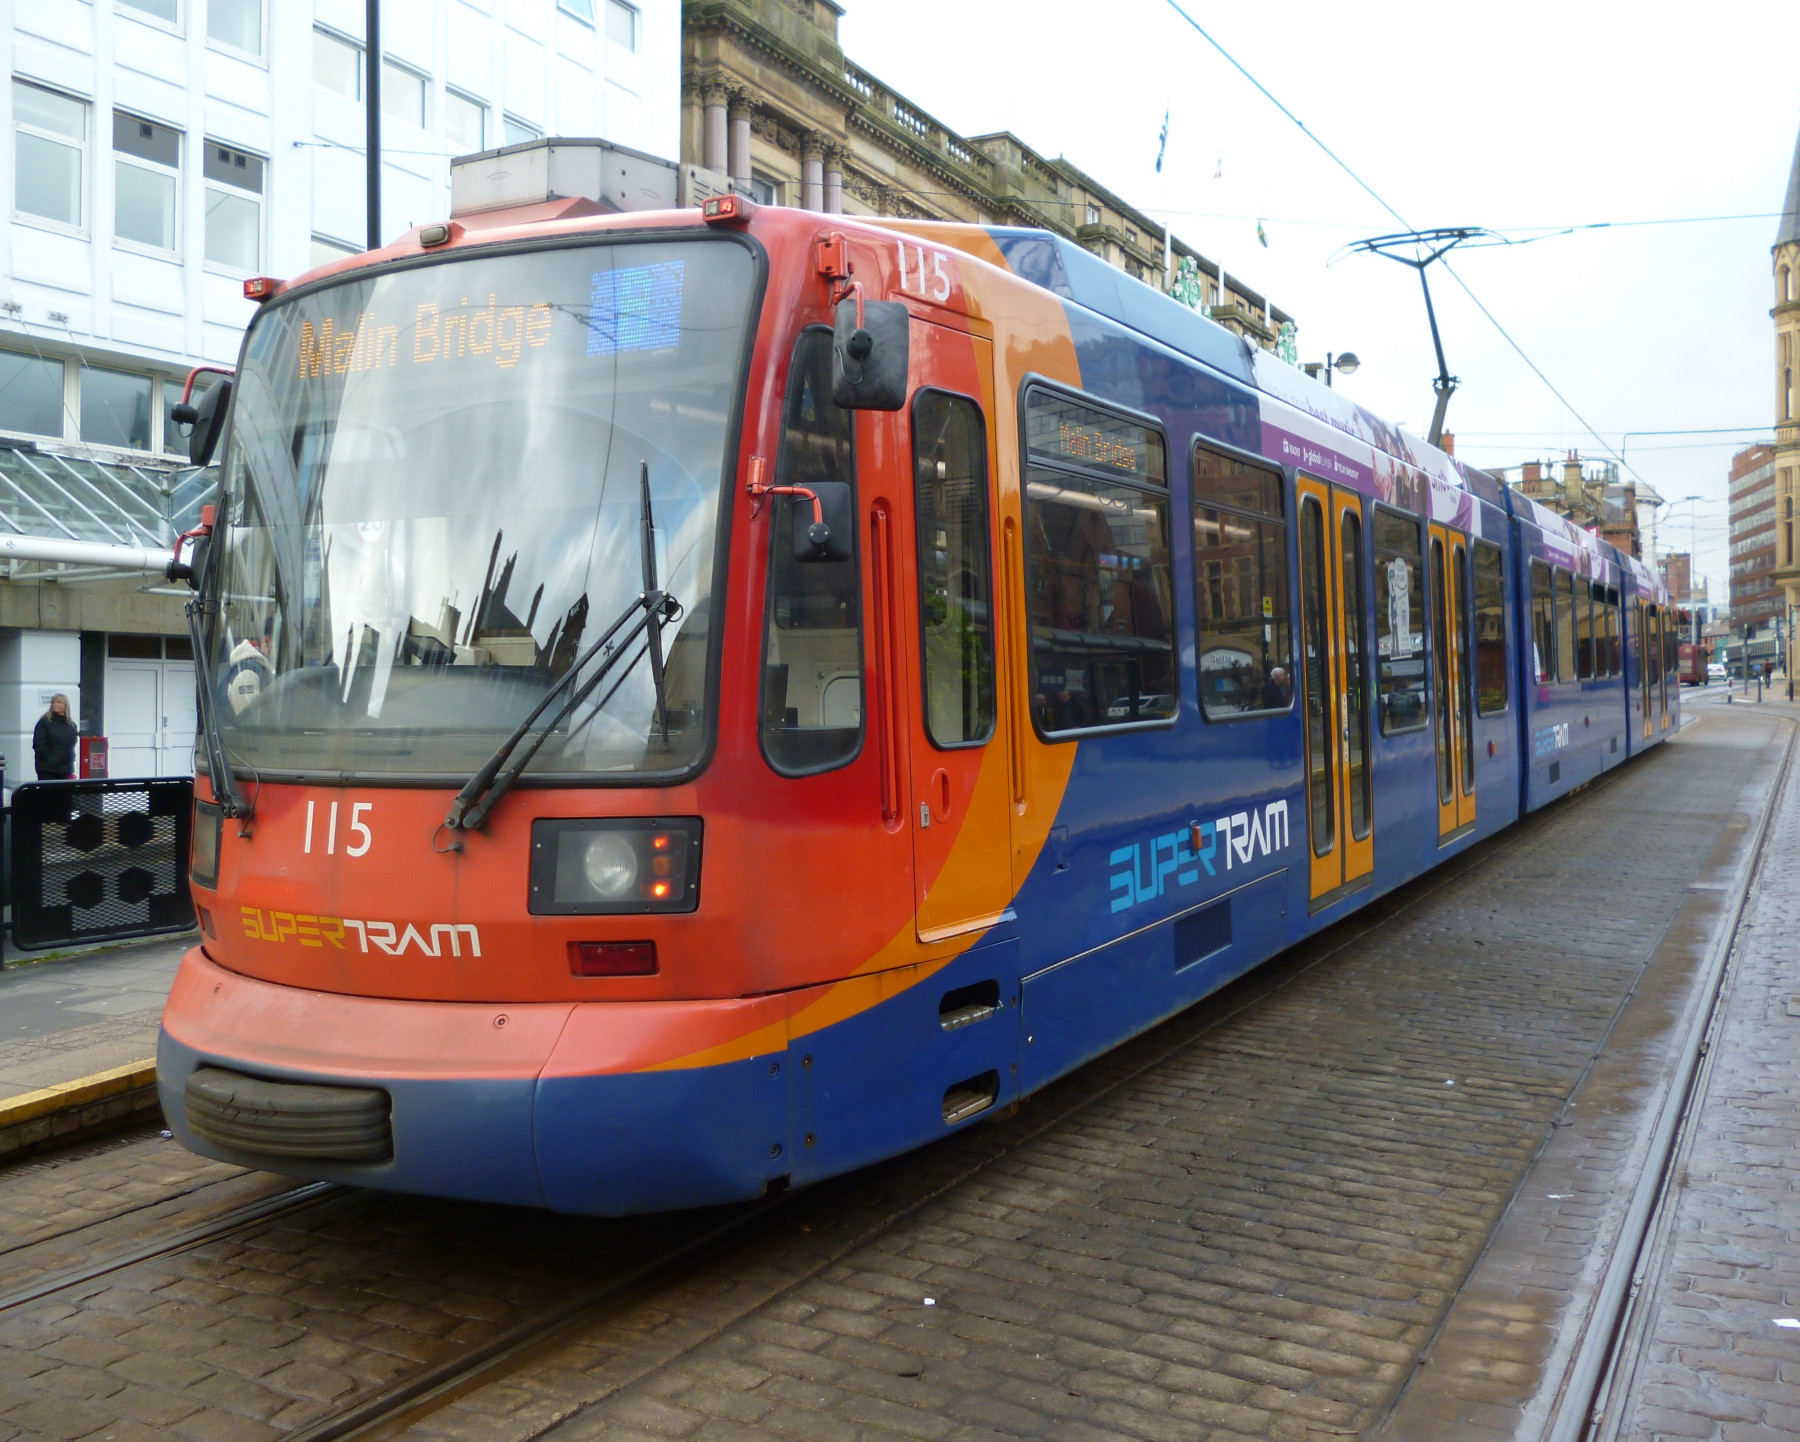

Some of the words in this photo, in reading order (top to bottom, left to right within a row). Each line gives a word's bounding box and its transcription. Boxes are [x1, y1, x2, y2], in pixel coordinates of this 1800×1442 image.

[897, 240, 950, 302] 115
[299, 311, 398, 378] Malin
[413, 292, 552, 368] Bridge
[304, 801, 373, 857] 115
[1109, 799, 1289, 914] SUPERTRAM
[240, 906, 482, 957] SUPERTRAM
